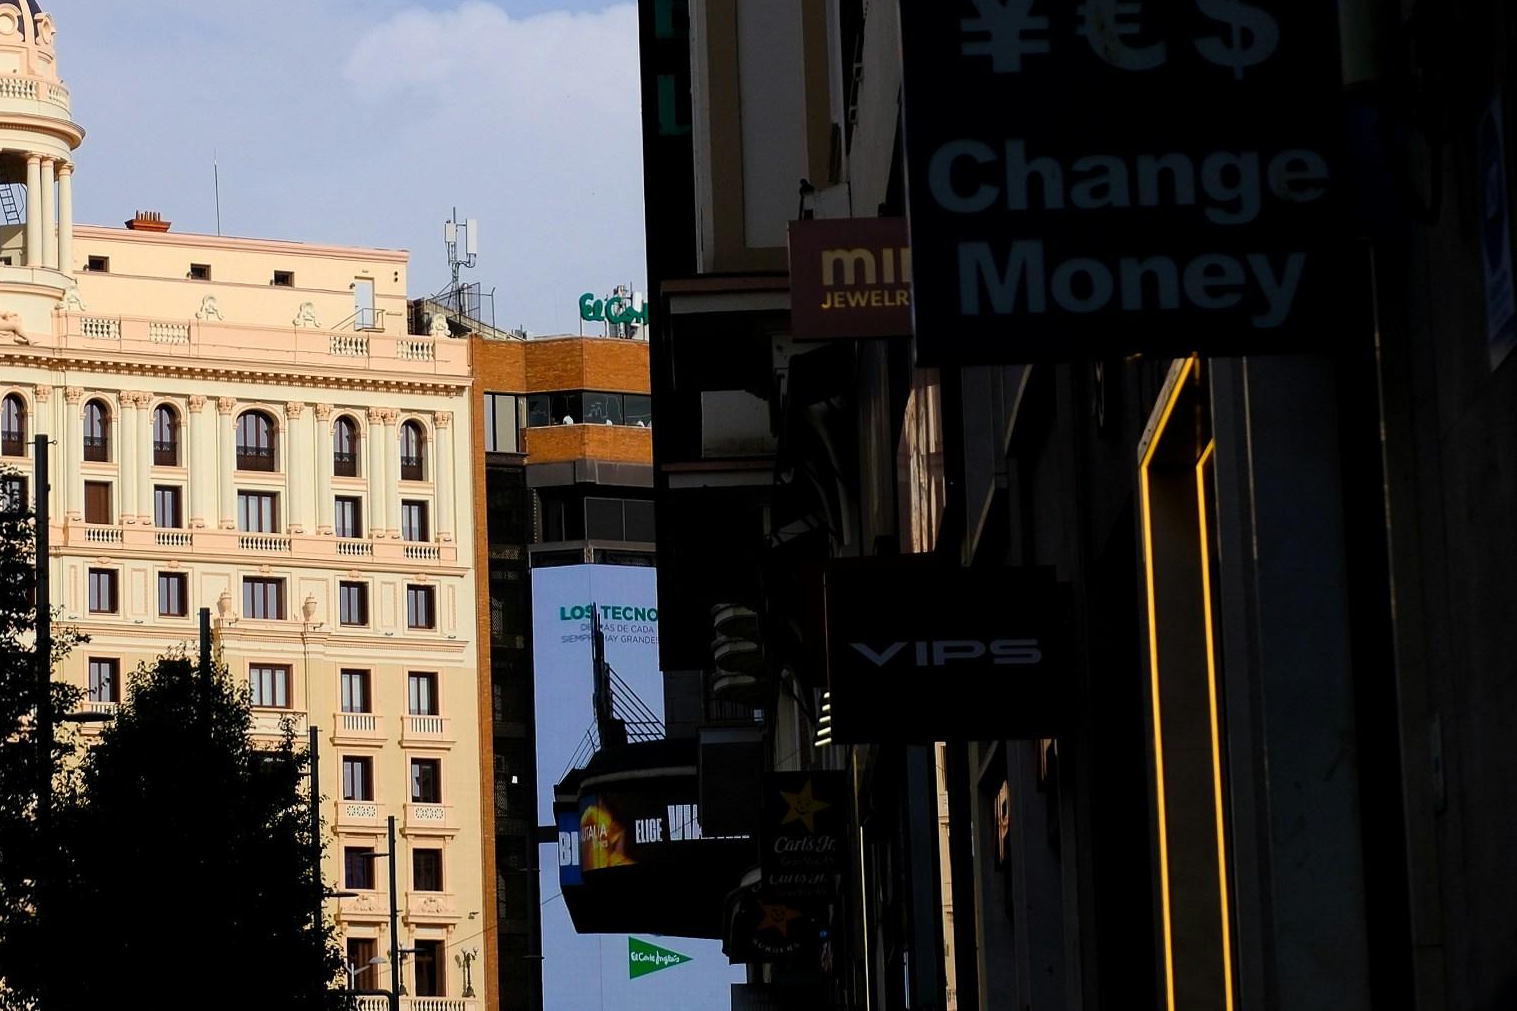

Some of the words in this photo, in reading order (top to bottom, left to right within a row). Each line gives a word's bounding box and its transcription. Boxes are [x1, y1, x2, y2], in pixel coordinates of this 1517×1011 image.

[927, 137, 1331, 226] Change
[957, 238, 1308, 329] Money
[630, 624, 655, 634] CADA
[849, 638, 1044, 668] VIPS
[635, 817, 663, 845] ELIGE
[816, 835, 837, 853] Jr.
